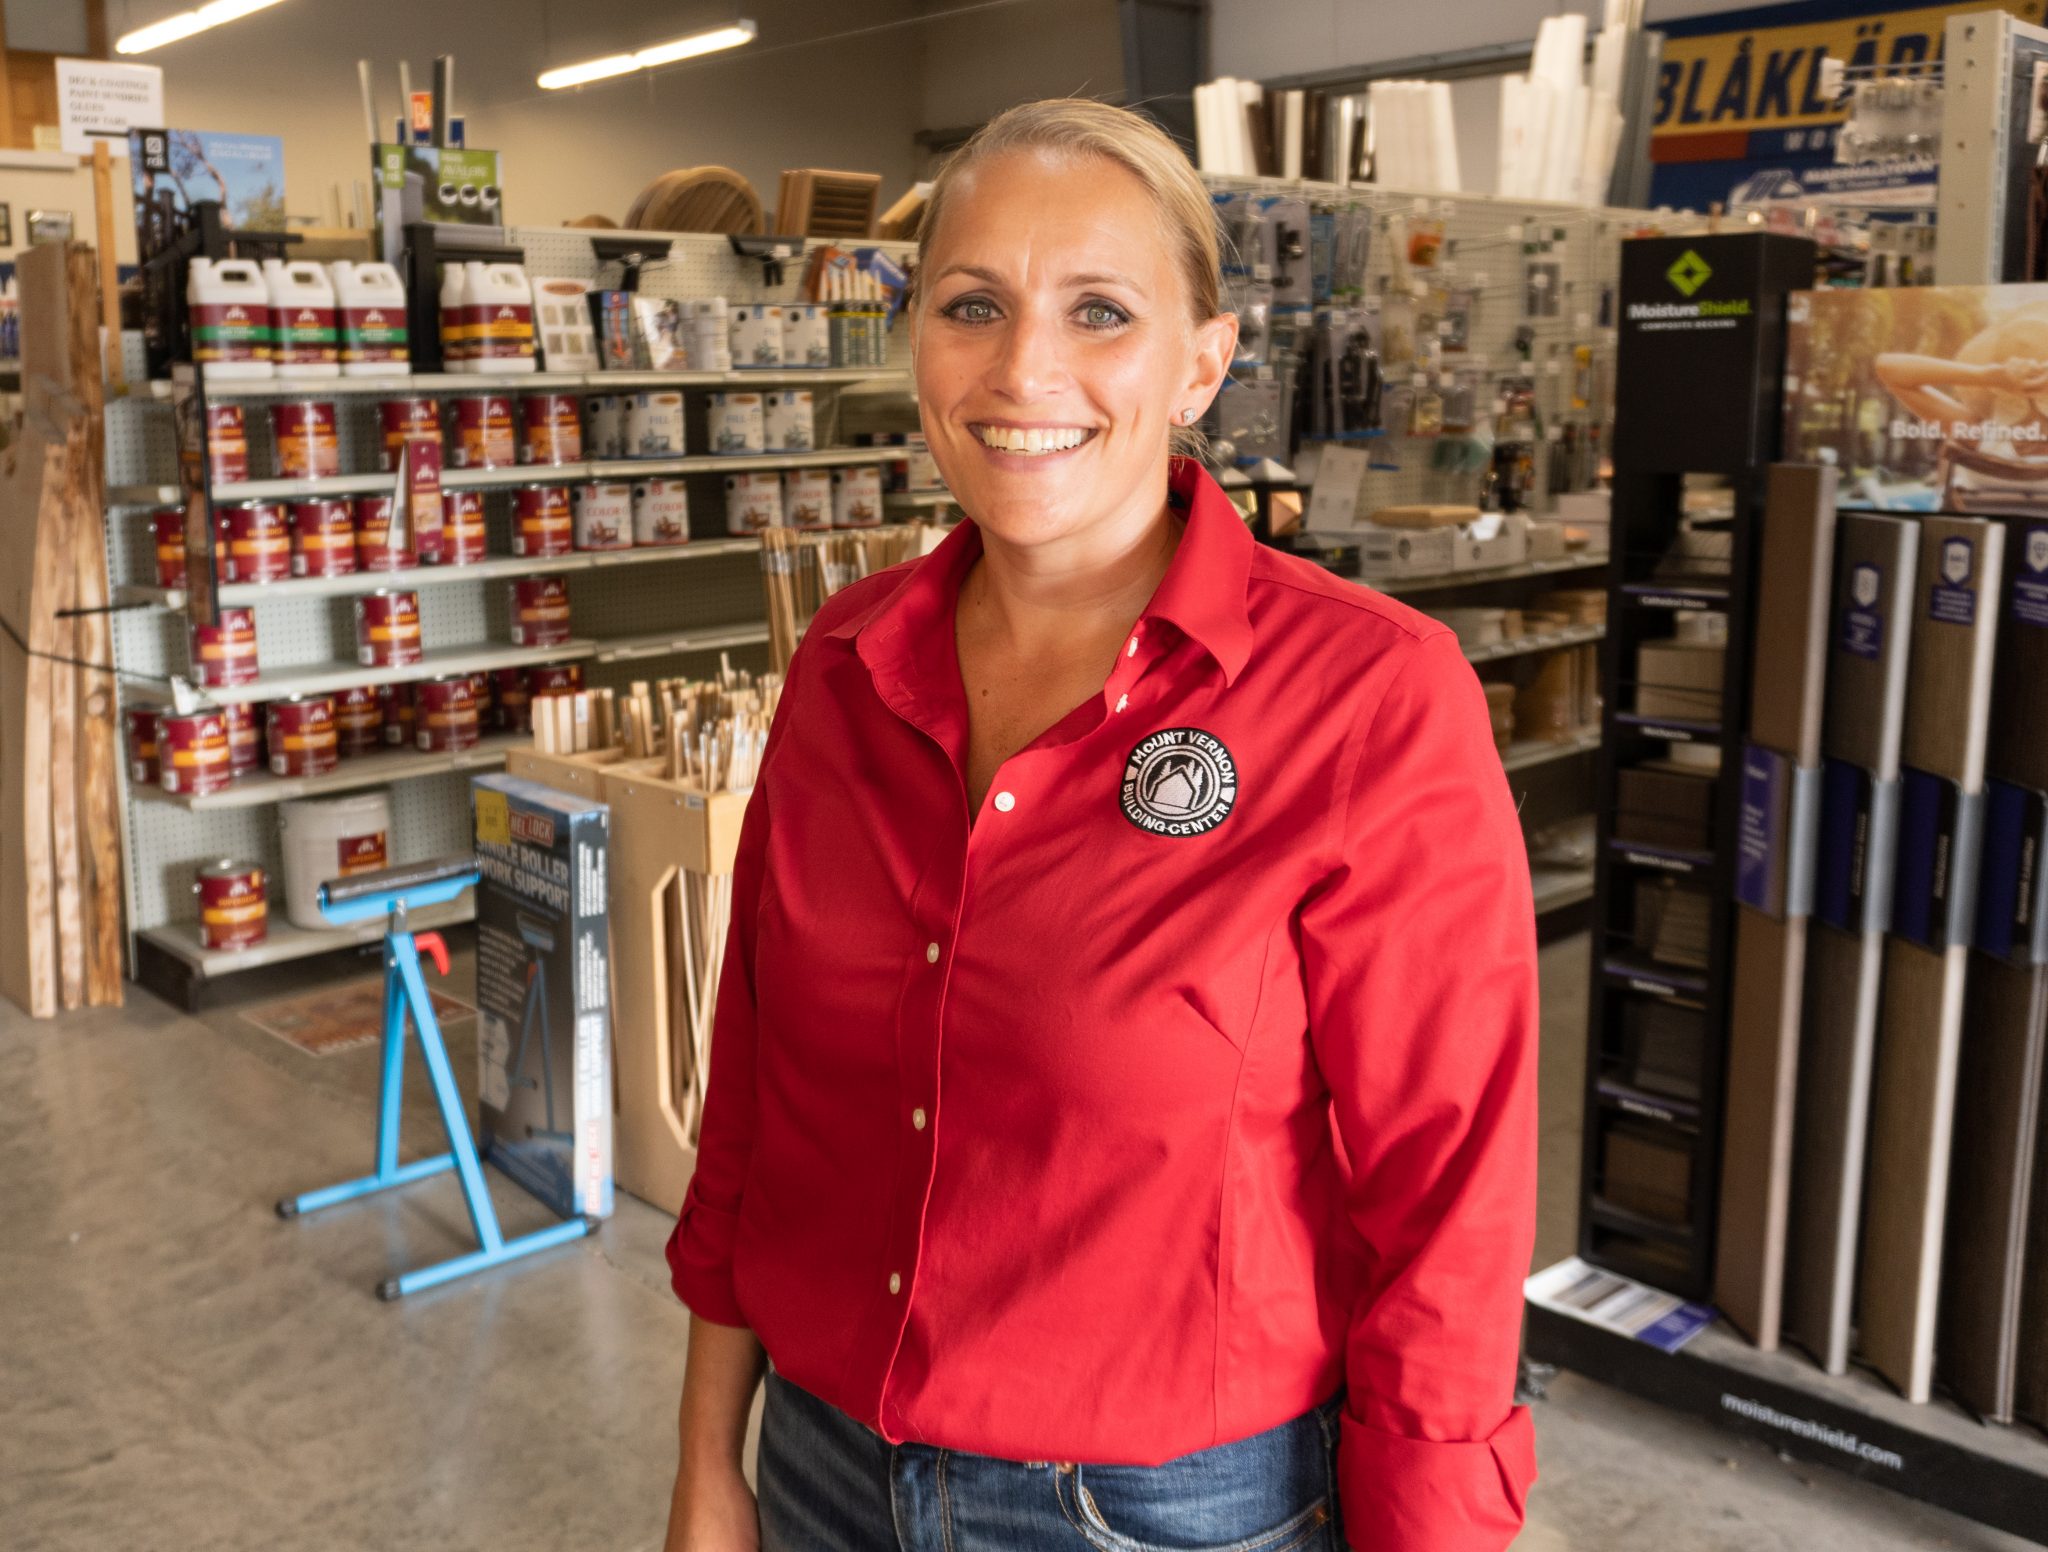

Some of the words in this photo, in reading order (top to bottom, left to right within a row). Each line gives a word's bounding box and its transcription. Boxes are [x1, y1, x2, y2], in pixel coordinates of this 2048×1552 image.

[1891, 420, 1947, 439] Bold.
[1953, 420, 2047, 440] Refined.
[1131, 731, 1185, 765] MOUNT
[1188, 730, 1235, 784] VERNON
[1123, 782, 1167, 833] BUILDING
[1167, 802, 1230, 835] CENTER
[479, 853, 512, 883] WORK
[514, 868, 570, 912] SUPPORT
[520, 845, 569, 883] ROLLER
[1721, 1392, 1904, 1471] moistureshield.com
